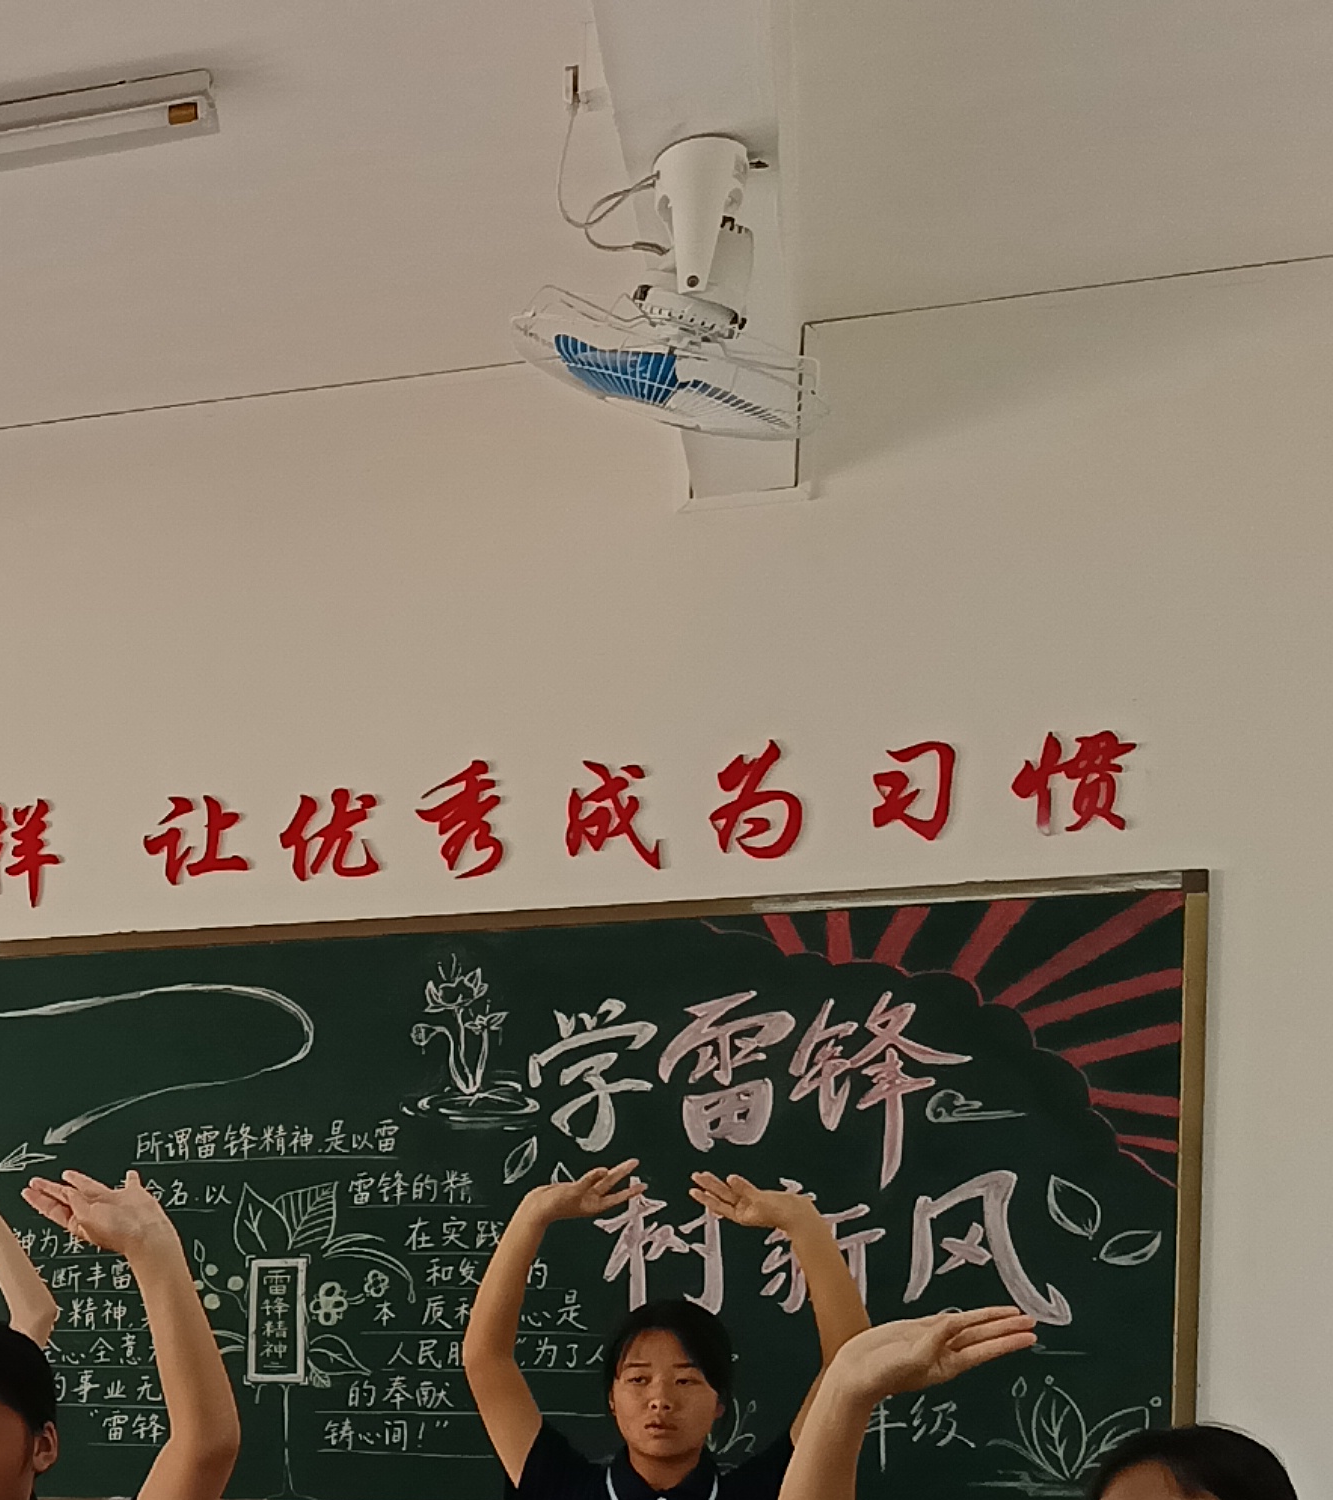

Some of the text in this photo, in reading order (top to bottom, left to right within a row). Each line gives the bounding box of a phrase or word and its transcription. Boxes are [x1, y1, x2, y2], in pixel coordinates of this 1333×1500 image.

[143, 731, 1137, 885] 让优秀成为习惯
[529, 990, 973, 1189] 学雷锋
[260, 1270, 291, 1358] 雷锋精神
